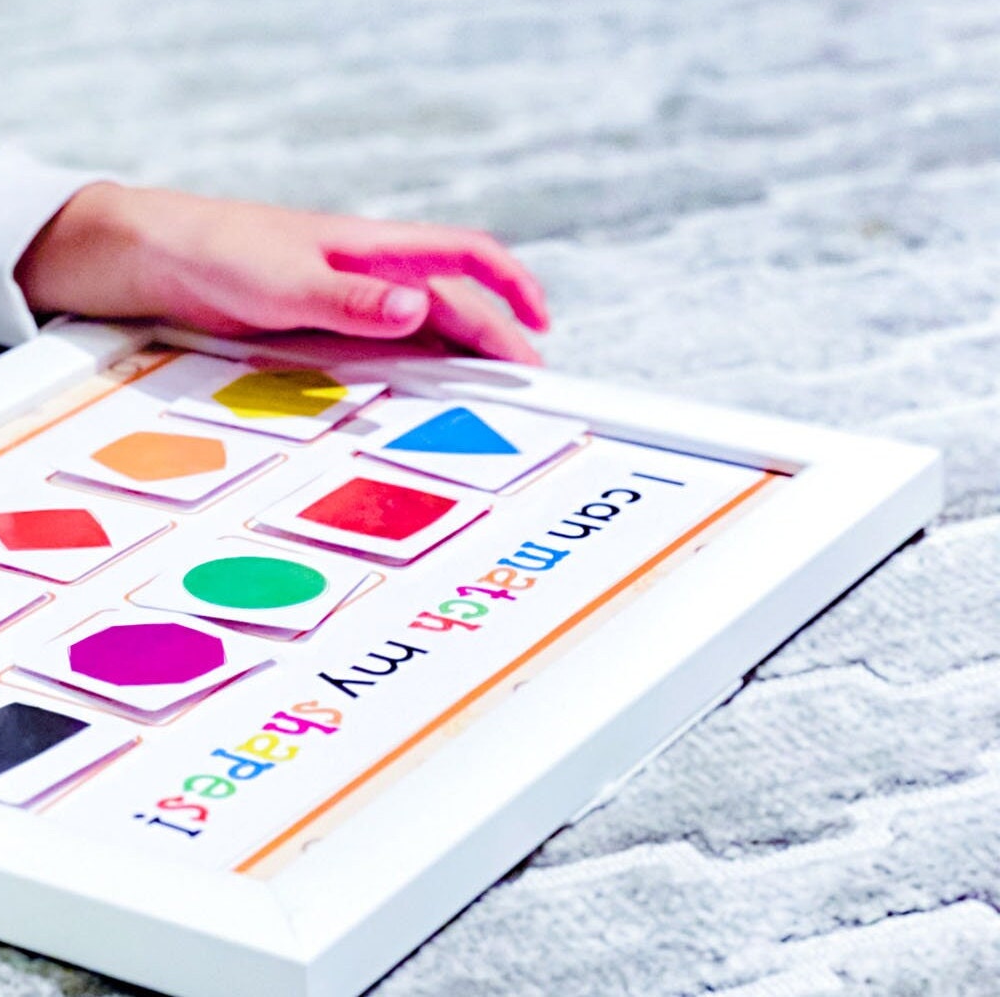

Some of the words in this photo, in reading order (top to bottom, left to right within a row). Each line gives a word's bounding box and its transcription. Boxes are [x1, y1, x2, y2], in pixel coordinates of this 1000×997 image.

[631, 472, 685, 486] I
[547, 488, 642, 540] can
[407, 541, 571, 632] match
[317, 640, 429, 698] my
[133, 700, 342, 837] shapes!
